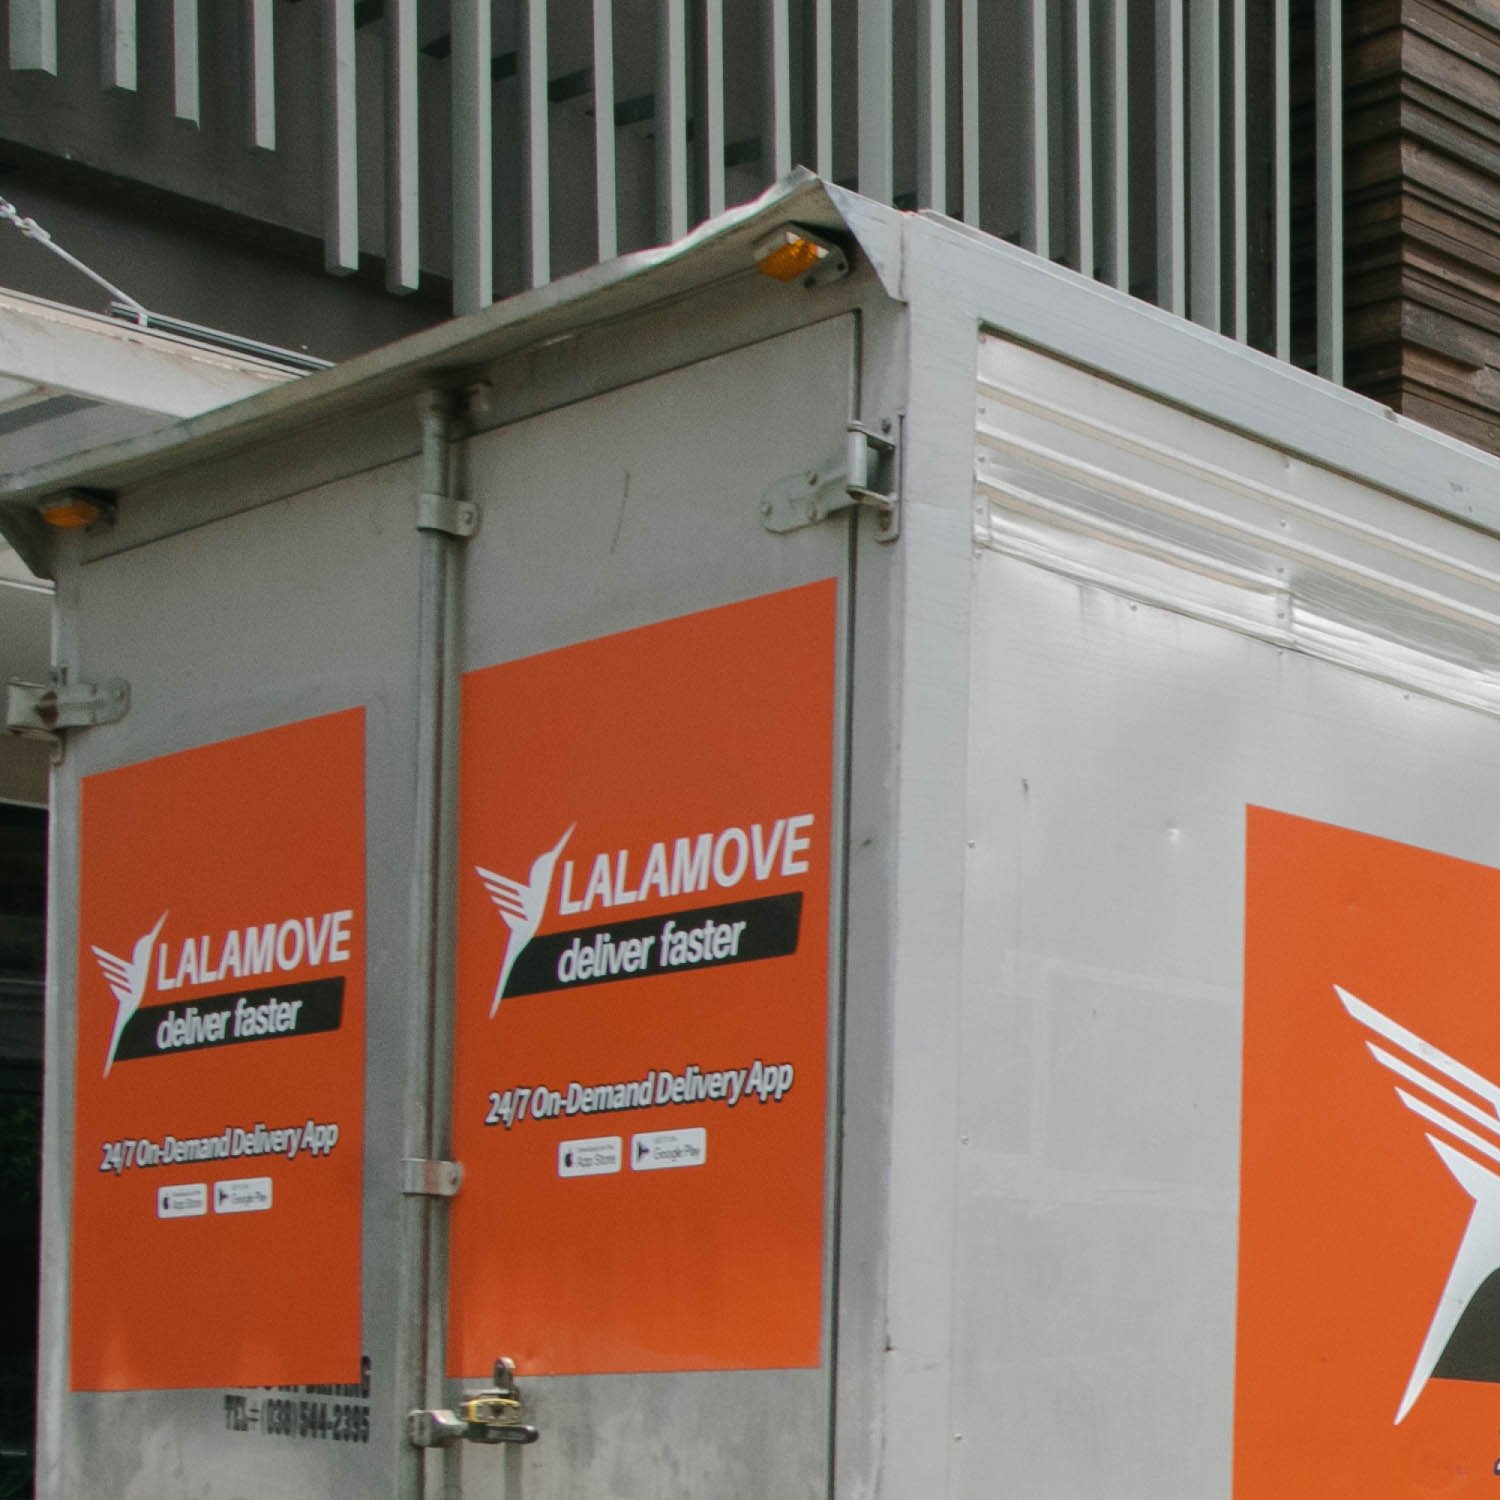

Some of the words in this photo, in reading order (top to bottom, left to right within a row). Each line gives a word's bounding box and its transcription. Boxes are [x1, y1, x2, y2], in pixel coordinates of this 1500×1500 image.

[558, 813, 815, 915] LALAMOVE
[156, 910, 352, 991] LALAMOVE
[557, 929, 655, 983] deliver
[659, 917, 746, 968] faster
[157, 1003, 230, 1051] deliver
[234, 997, 302, 1040] faster
[486, 1090, 528, 1128] 24/7
[531, 1078, 653, 1120] On-Demand
[656, 1068, 750, 1113] Delivery
[747, 1060, 794, 1102] App
[100, 1140, 134, 1173] 24/7
[137, 1128, 230, 1168] On-Demand
[232, 1122, 304, 1161] Delivery
[303, 1120, 339, 1154] App
